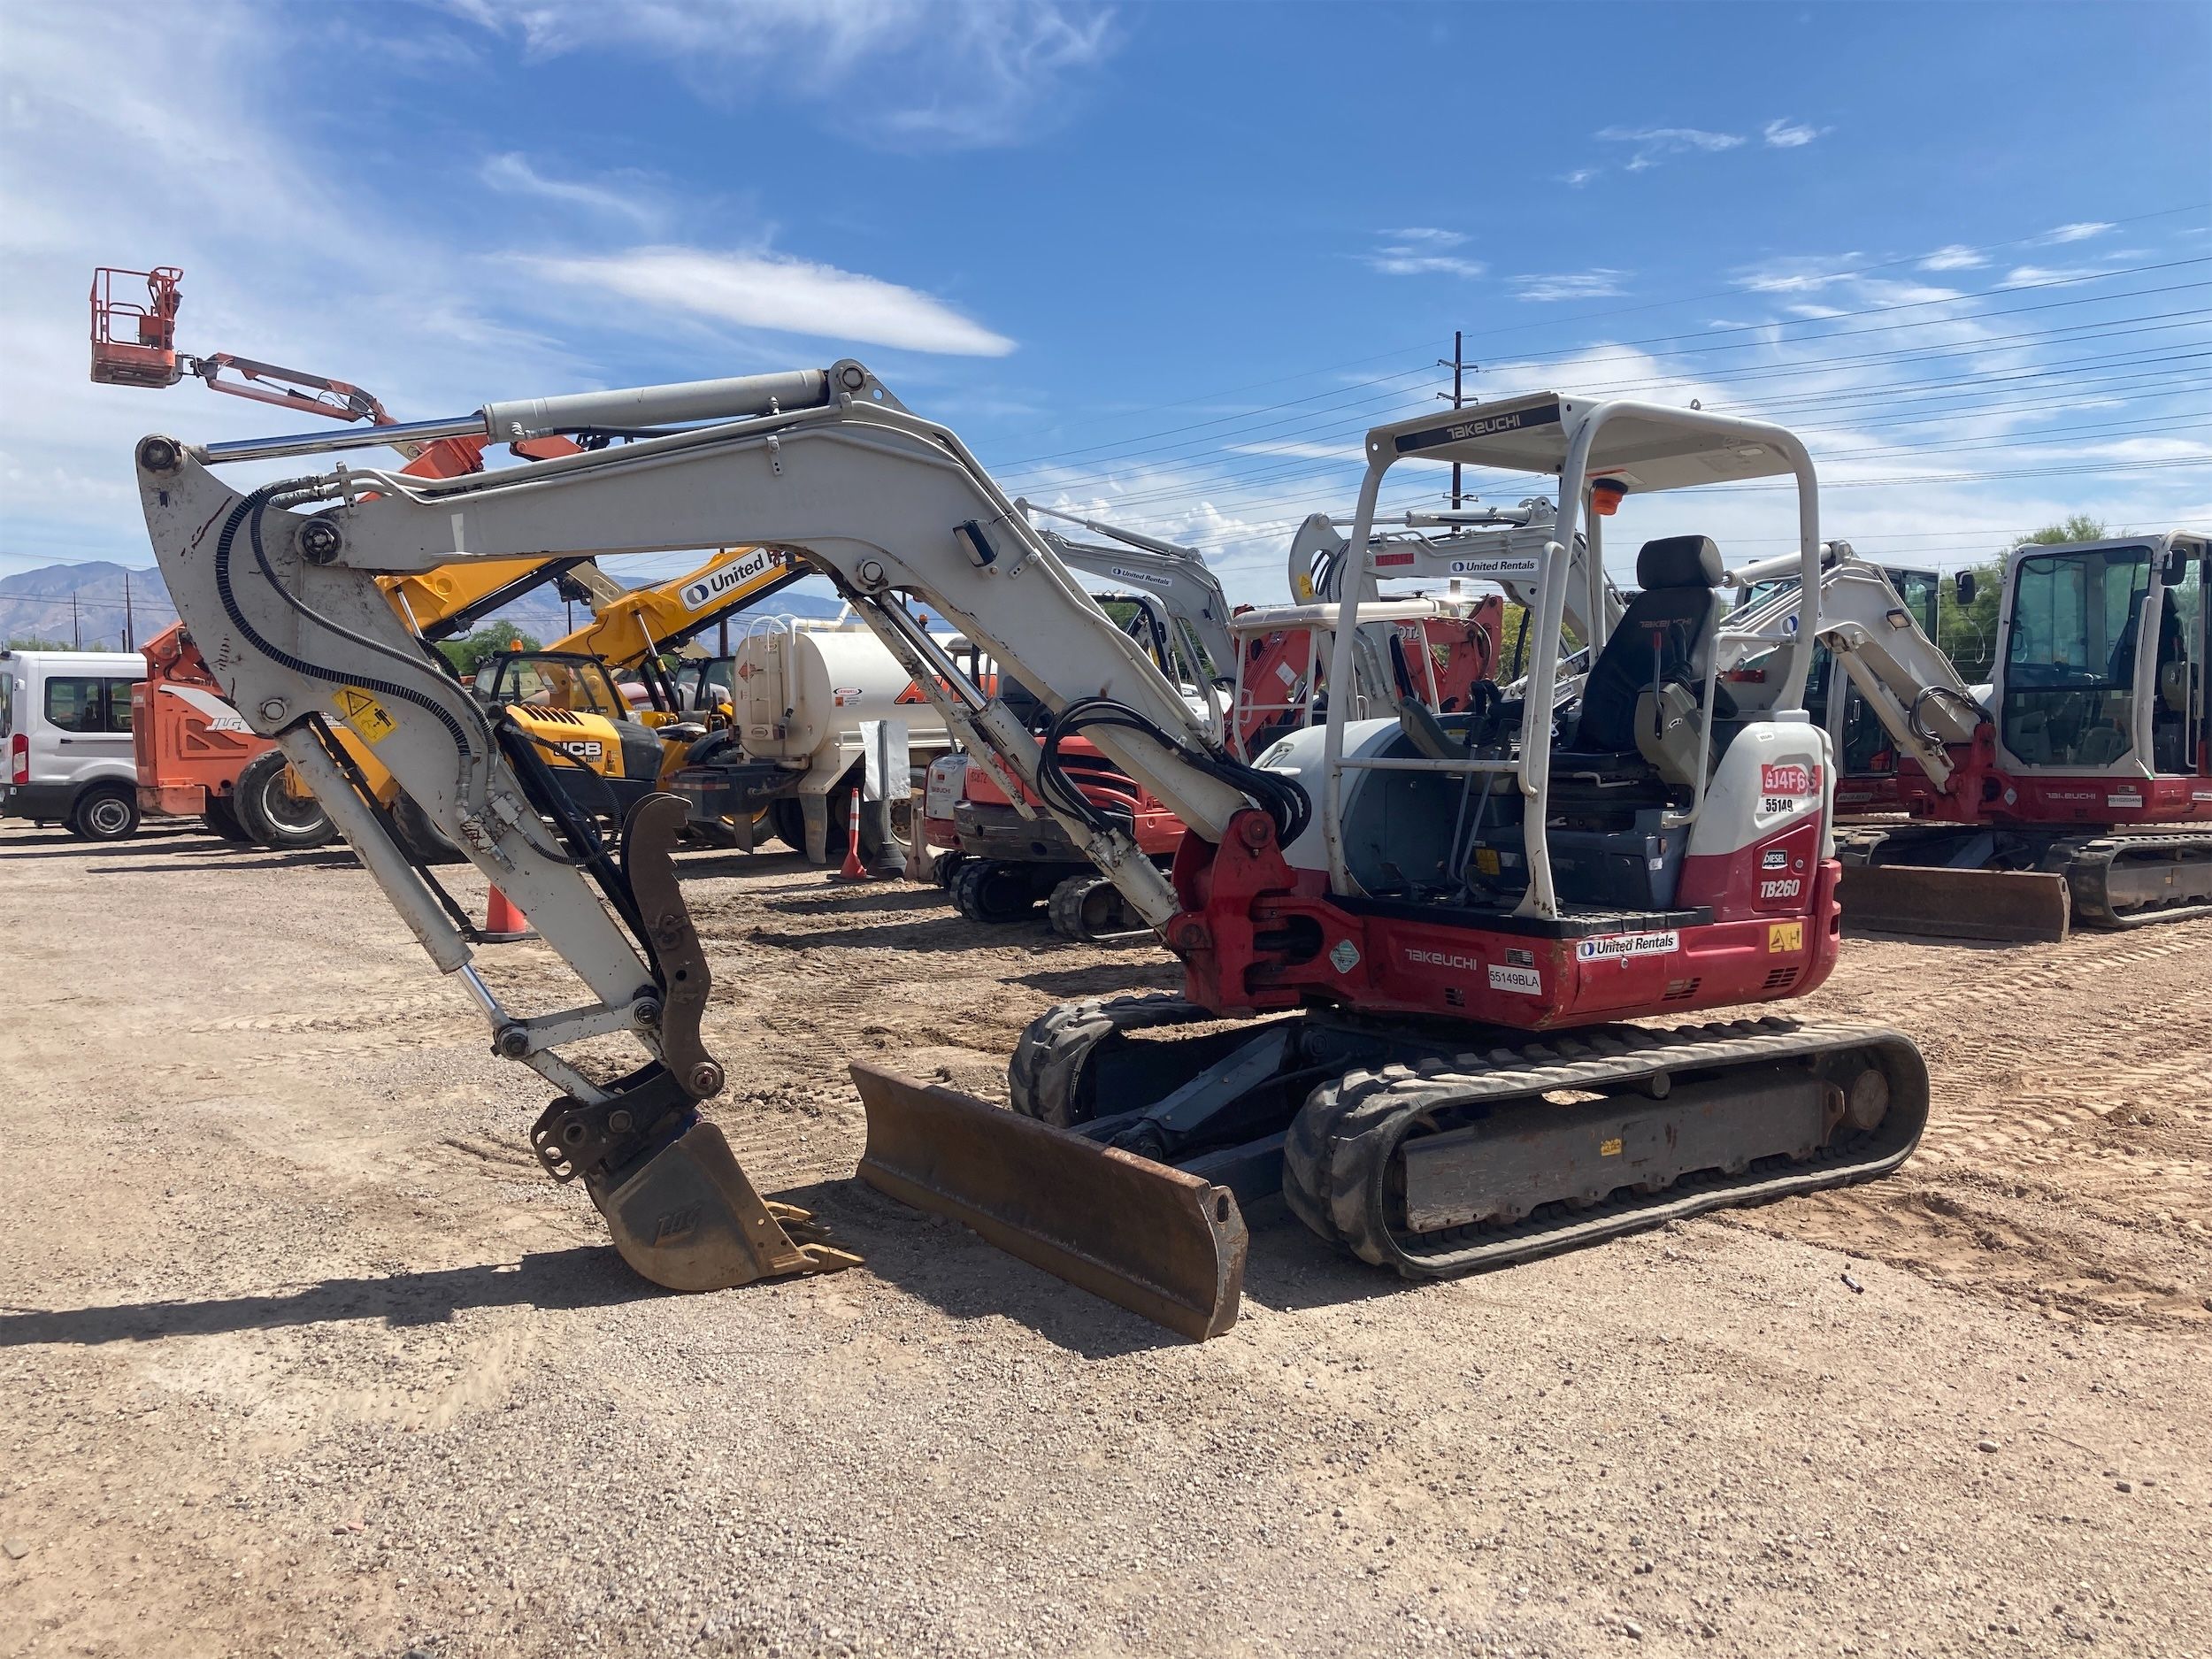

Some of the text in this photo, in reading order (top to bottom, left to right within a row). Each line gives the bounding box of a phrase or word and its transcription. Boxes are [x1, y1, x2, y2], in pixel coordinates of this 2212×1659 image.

[1447, 414, 1521, 440] TAKEUCHI
[711, 553, 764, 592] United
[1466, 560, 1535, 572] United Rentals
[1122, 570, 1170, 585] United Rentals
[204, 718, 244, 732] JLG
[1765, 798, 1793, 812] 55149
[1763, 854, 1786, 864] DIESEL
[1760, 879, 1801, 899] TB260
[1597, 934, 1674, 954] United Rentals
[1405, 948, 1478, 971] TAKEUCHI
[1489, 971, 1540, 987] 55149BLA
